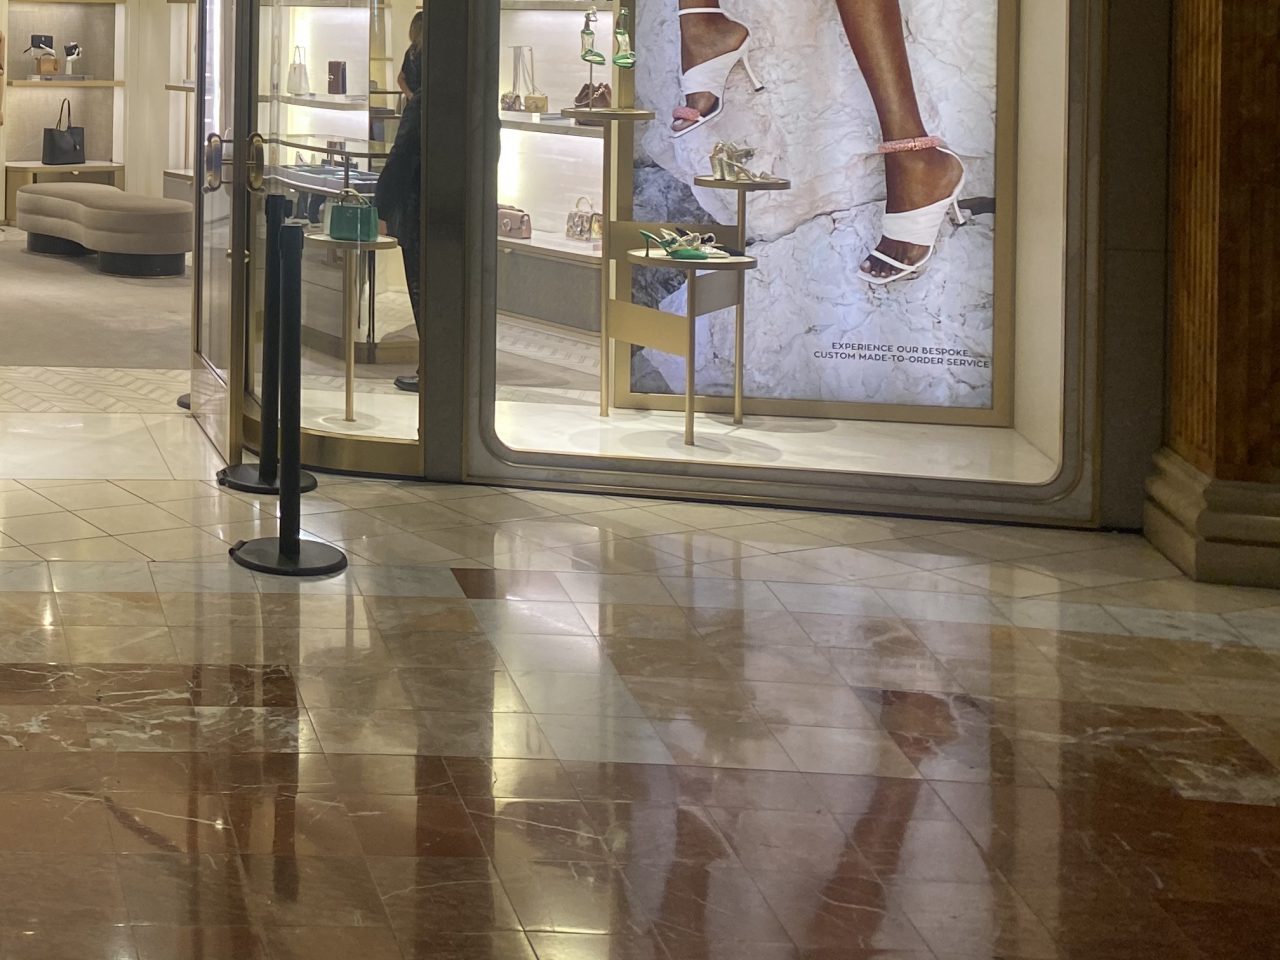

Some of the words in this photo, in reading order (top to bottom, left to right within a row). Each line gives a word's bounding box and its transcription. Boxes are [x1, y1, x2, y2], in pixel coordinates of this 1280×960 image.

[831, 342, 894, 353] EXPERIENCE
[896, 345, 919, 354] OUR
[922, 346, 969, 357] BESPOKE
[813, 350, 856, 360] CUSTOM
[858, 353, 944, 365] MADE-TO-ORDER
[946, 359, 990, 368] SERVICE
